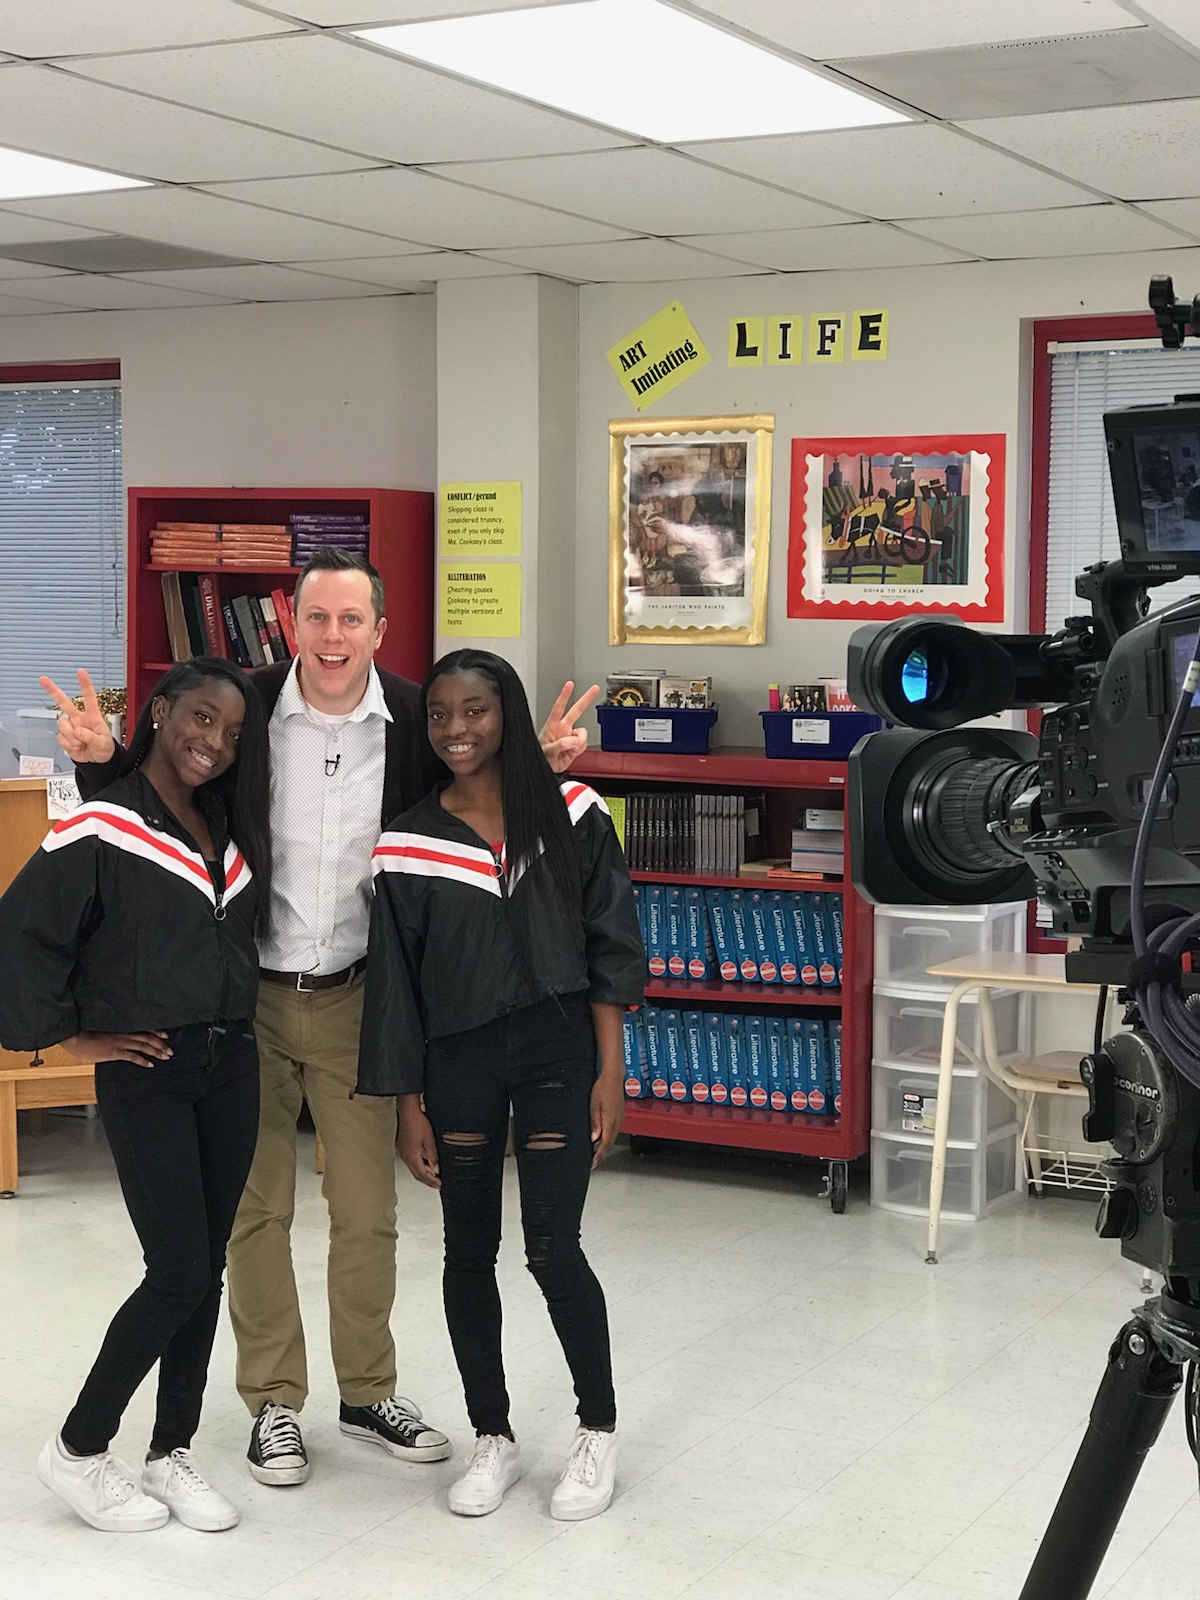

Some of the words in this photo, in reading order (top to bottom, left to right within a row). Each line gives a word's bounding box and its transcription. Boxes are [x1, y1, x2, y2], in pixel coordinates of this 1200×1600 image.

[618, 340, 648, 372] ART
[735, 313, 883, 360] LIFE
[630, 338, 698, 396] Imitating
[448, 505, 472, 514] Skipping
[480, 527, 492, 535] only
[493, 527, 505, 535] skip
[447, 573, 487, 581] ALLITERATION
[447, 586, 472, 594] Cheating
[447, 596, 471, 605] Cooksey
[447, 608, 470, 616] multiple
[495, 607, 503, 615] of
[651, 903, 659, 945] Literature
[689, 905, 699, 948] Literature
[712, 906, 726, 949] Literature
[752, 909, 766, 951] Literature
[772, 909, 786, 952] Literature
[793, 909, 806, 953] Literature
[832, 911, 843, 954] Literature
[623, 1023, 632, 1065] Literature
[648, 1025, 658, 1067] Literature
[667, 1027, 678, 1069] Literature
[689, 1028, 699, 1070] Literature
[750, 1034, 759, 1076] Literature
[770, 1035, 779, 1078] Literature
[809, 1038, 818, 1081] Literature
[833, 1038, 842, 1082] Literature
